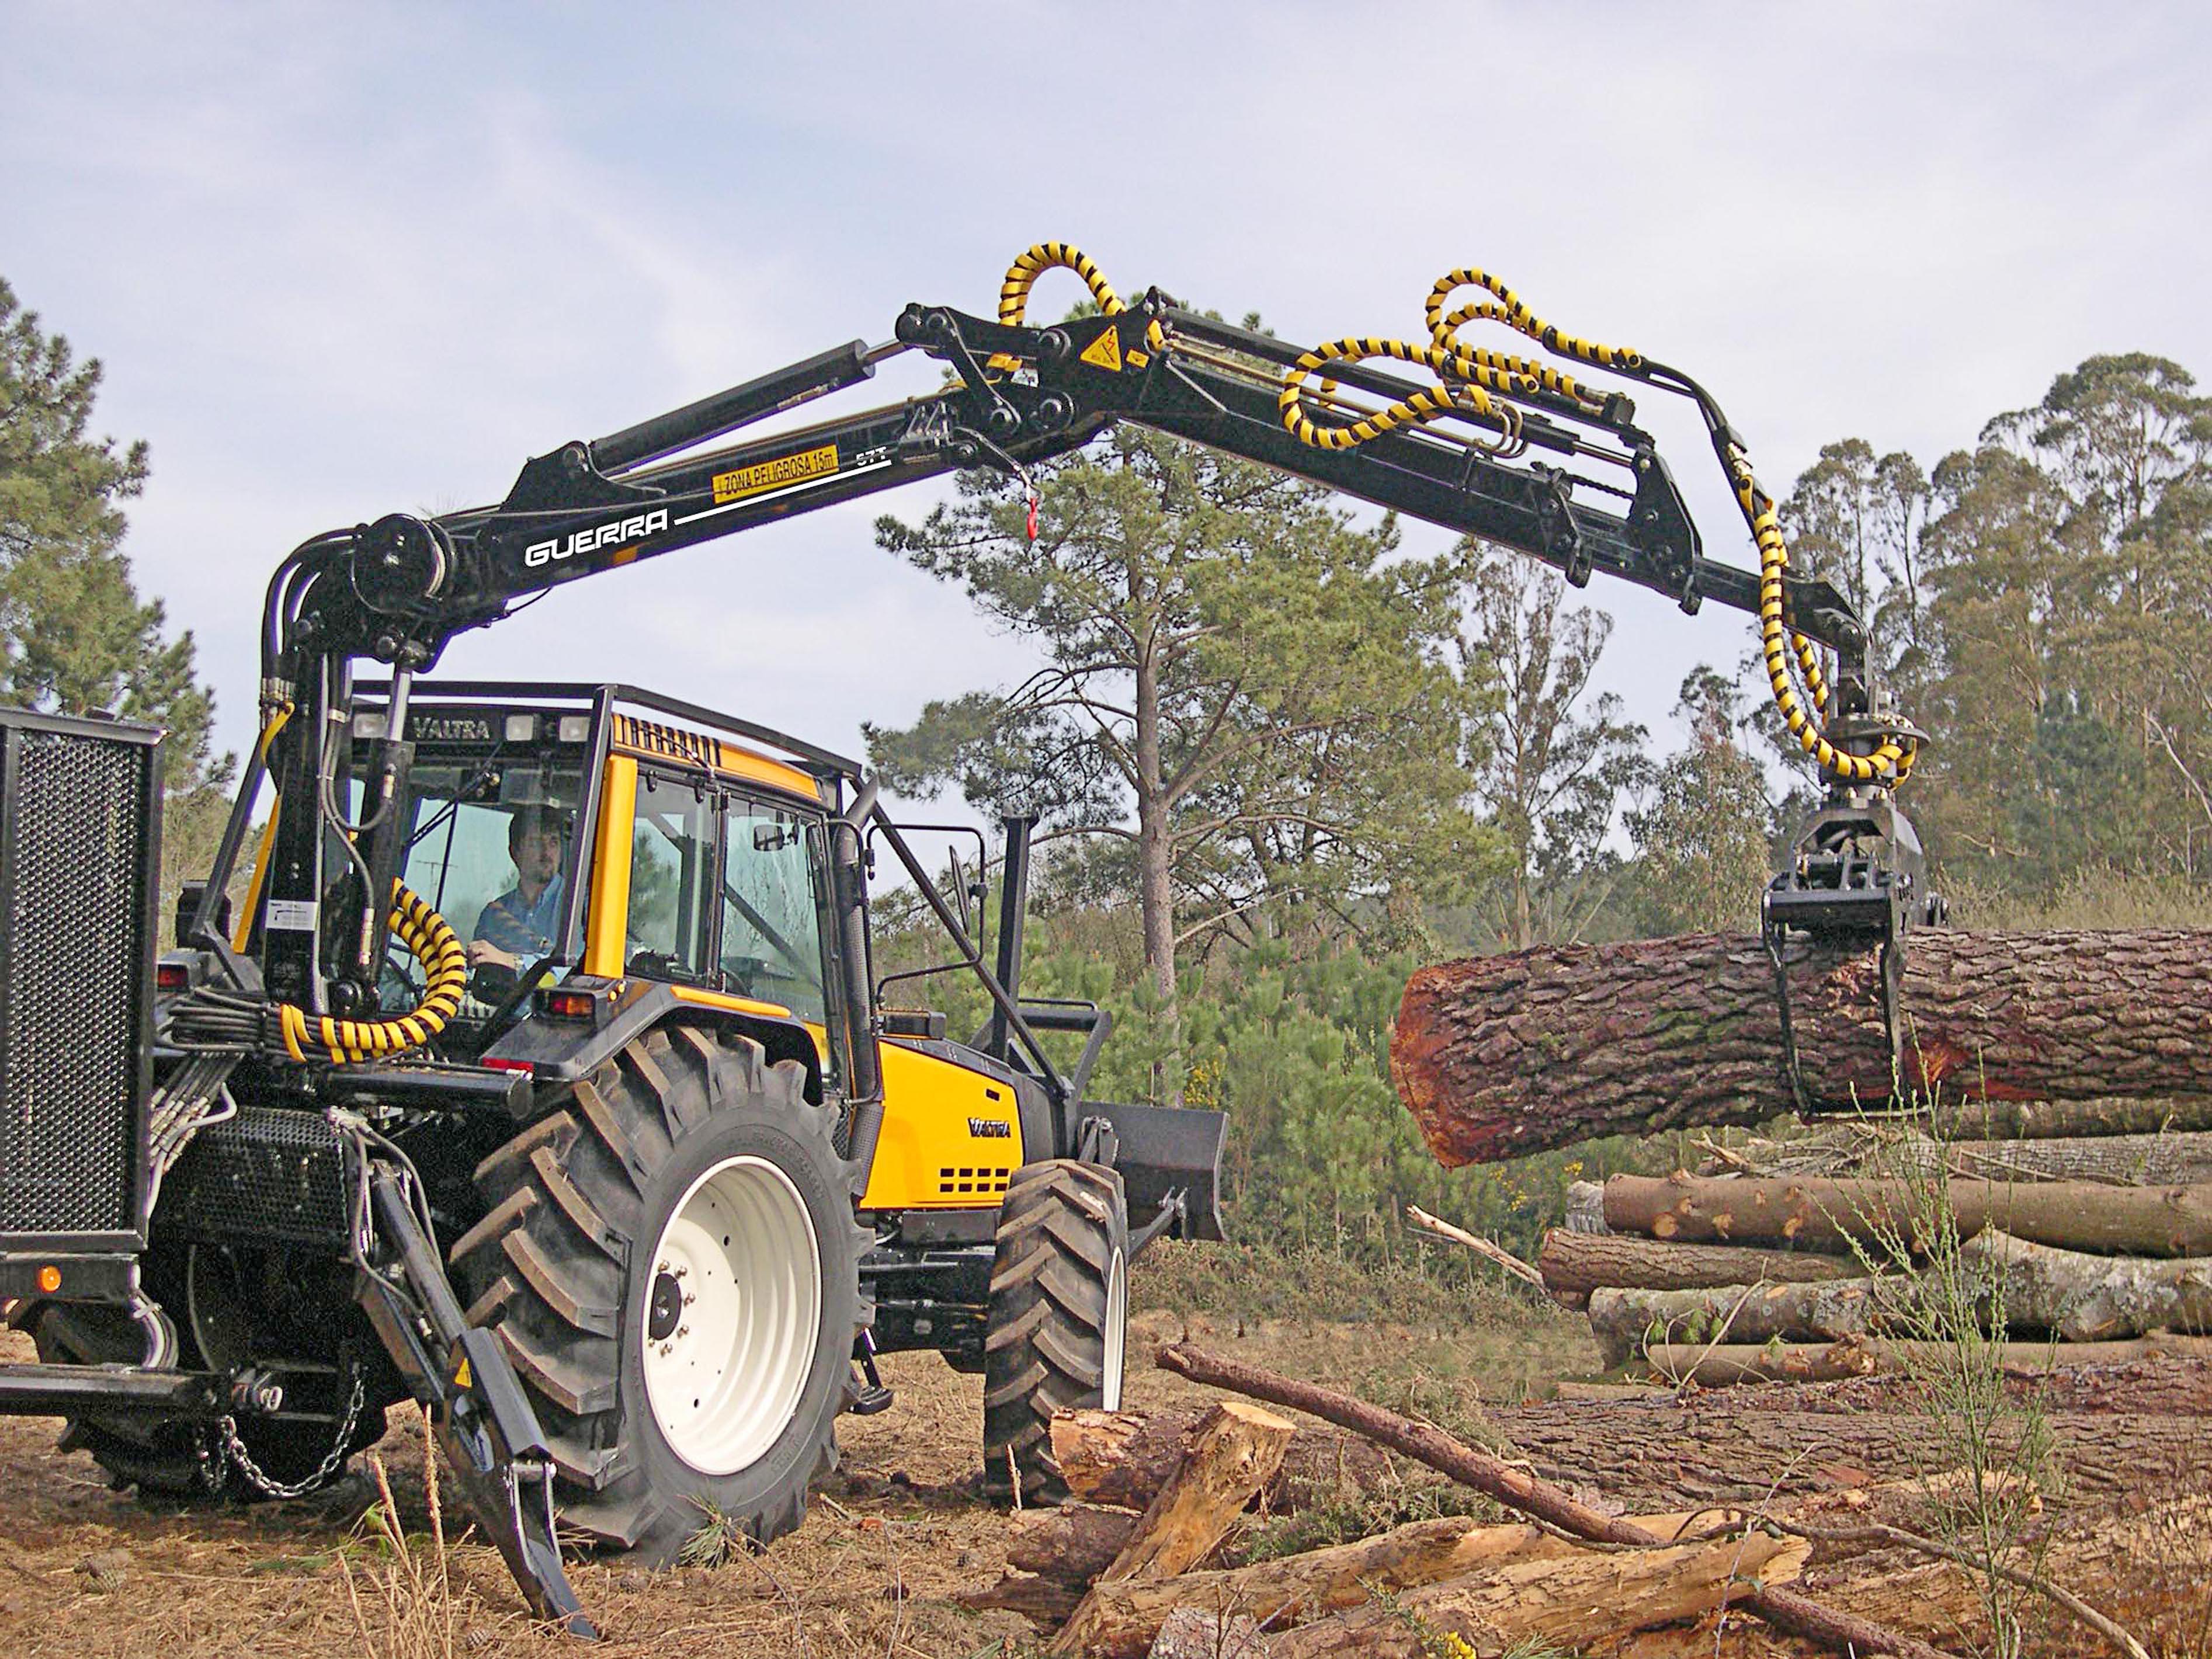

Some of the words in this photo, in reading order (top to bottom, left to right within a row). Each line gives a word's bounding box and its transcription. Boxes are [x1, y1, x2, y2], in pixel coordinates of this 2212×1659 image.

[814, 451, 834, 471] 15m
[525, 508, 668, 567] GUERRA
[413, 716, 490, 739] VALTRA
